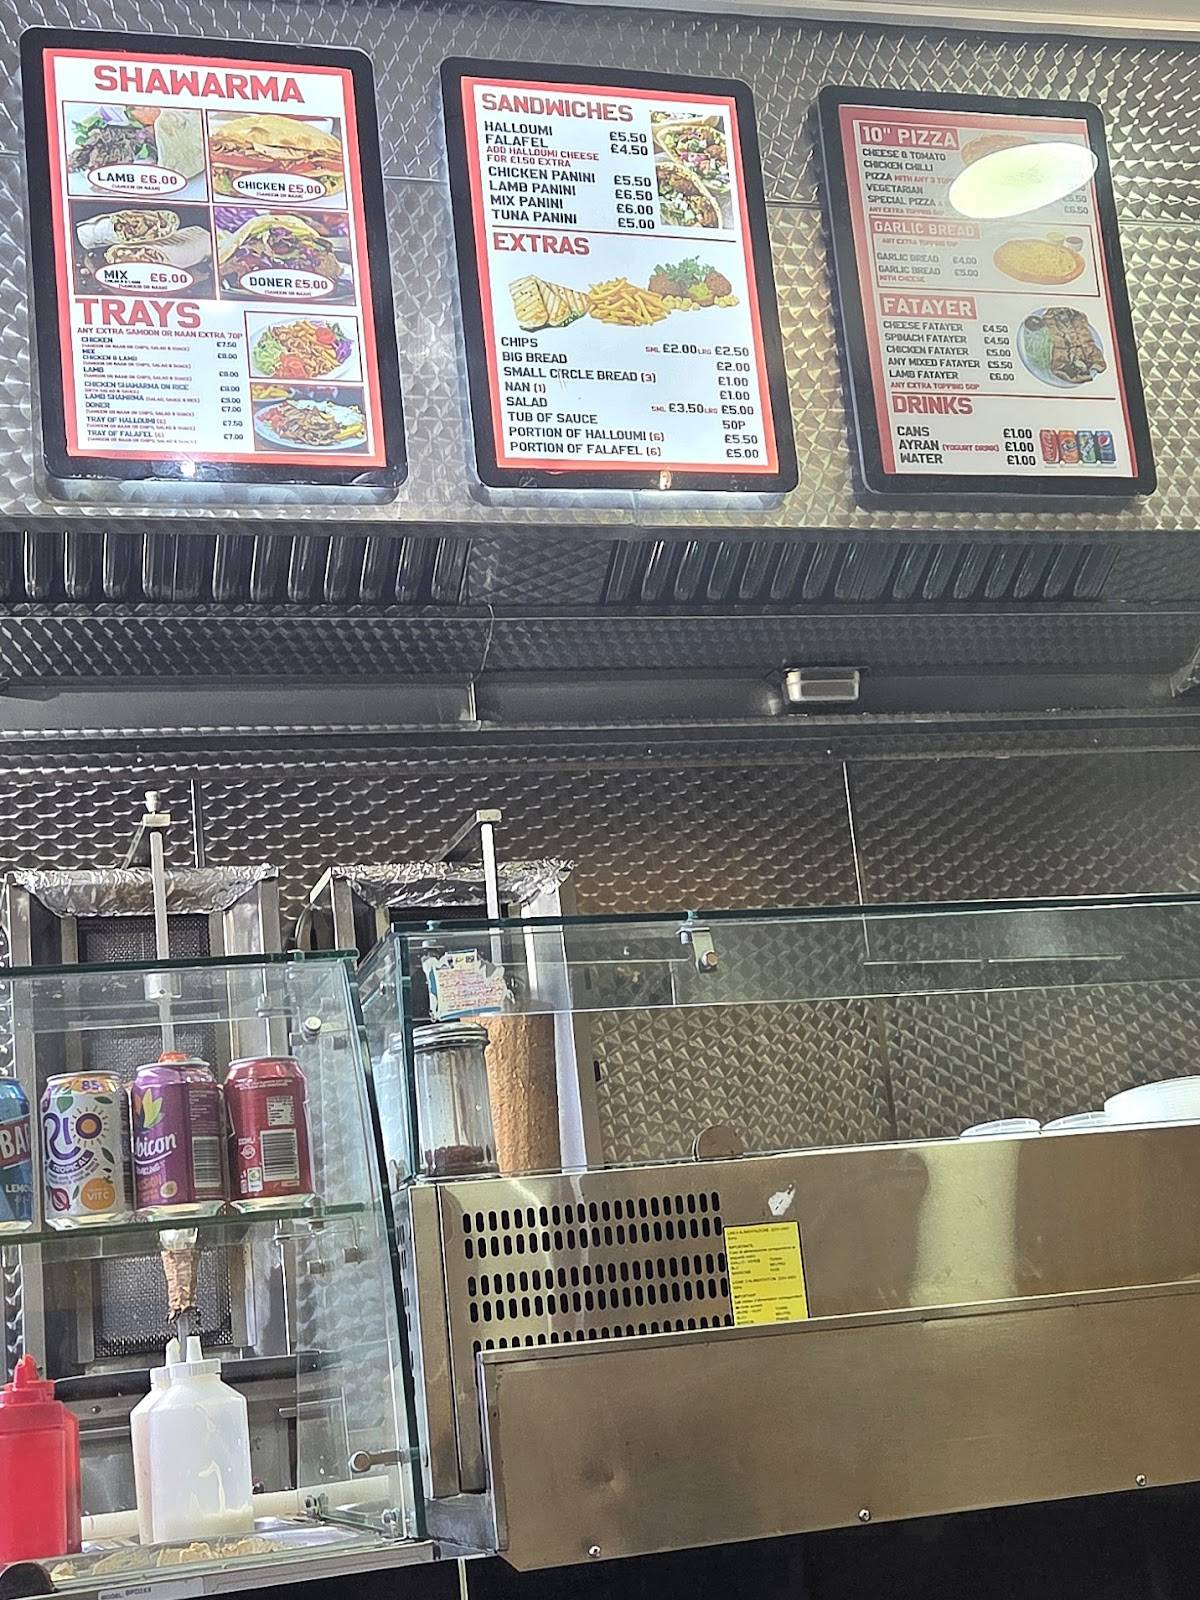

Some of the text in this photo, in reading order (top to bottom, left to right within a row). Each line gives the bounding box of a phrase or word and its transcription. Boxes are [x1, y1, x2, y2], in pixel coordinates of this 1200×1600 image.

[94, 65, 305, 103] SHAWARMA
[482, 93, 634, 122] SANDWICHES
[484, 121, 647, 144] HALLOUMI £5.50
[862, 126, 957, 148] 10" PIZZA
[486, 134, 648, 156] FALAFEL £4.50
[486, 146, 599, 161] ADD HALLOUMI CHEESE
[487, 154, 571, 168] FOR £1.50 EXTRA
[862, 149, 899, 158] CHEESE
[911, 152, 946, 161] TOMATO
[864, 160, 933, 172] CHICKEN CHILLI
[98, 172, 178, 185] LAMB £6.00
[488, 166, 652, 187] CHICKEN PANINI £5.50
[865, 172, 893, 181] PIZZA
[238, 181, 321, 194] CHICKEN £5.00
[490, 180, 653, 201] LAMB PANINI £6.50
[866, 183, 923, 194] VEGETARIAN
[490, 195, 653, 215] MIX PANINI £6.00
[868, 195, 907, 205] SPECIAL
[909, 198, 936, 207] PIZZA
[492, 209, 655, 230] TUNA PANINI £5.00
[874, 221, 975, 236] GARLIC BREAD
[493, 232, 590, 256] EXTRAS
[877, 253, 977, 264] GARLIC BREAD £4.00
[104, 270, 188, 284] MIX £6.00
[879, 265, 979, 277] GARLIC BREAD £5.00
[250, 277, 328, 290] DONER £5.00
[75, 298, 201, 329] TRAYS
[883, 298, 974, 316] FATAYER
[883, 321, 1008, 333] CHEESE FATAYER £4.50
[501, 337, 538, 348] CHIPS
[663, 344, 697, 354] £2.00
[715, 346, 749, 356] £2.50
[885, 333, 1010, 345] SPINACH FATAYER £4.50
[886, 345, 1011, 357] CHICKEN FATAYER £5.00
[502, 352, 750, 372] BIG BREAD £2.00
[888, 357, 1013, 369] ANY MIXED FATAYER £5.50
[504, 367, 546, 378] SMALL
[550, 369, 594, 380] CIRCLE
[597, 371, 638, 382] BREAD
[718, 377, 748, 387] £1.00
[889, 370, 1014, 381] LAMB FATAYER £6.00
[505, 382, 530, 392] NAN
[720, 391, 750, 401] £1.00
[506, 396, 754, 415] SALAD £3.50 £5.00
[892, 396, 974, 414] DRINKS
[508, 412, 746, 430] TUB OF SAUCE 50P
[509, 427, 758, 444] PORTION OF HALLOUMI £5.50
[897, 426, 1032, 438] CANS £1.00
[510, 442, 564, 453] PORTION
[567, 444, 583, 454] OF
[587, 444, 643, 455] FALAFEL
[727, 449, 759, 458] £5.00
[899, 439, 1034, 452] AYRAN £1.00
[900, 453, 1036, 465] WATER £1.00
